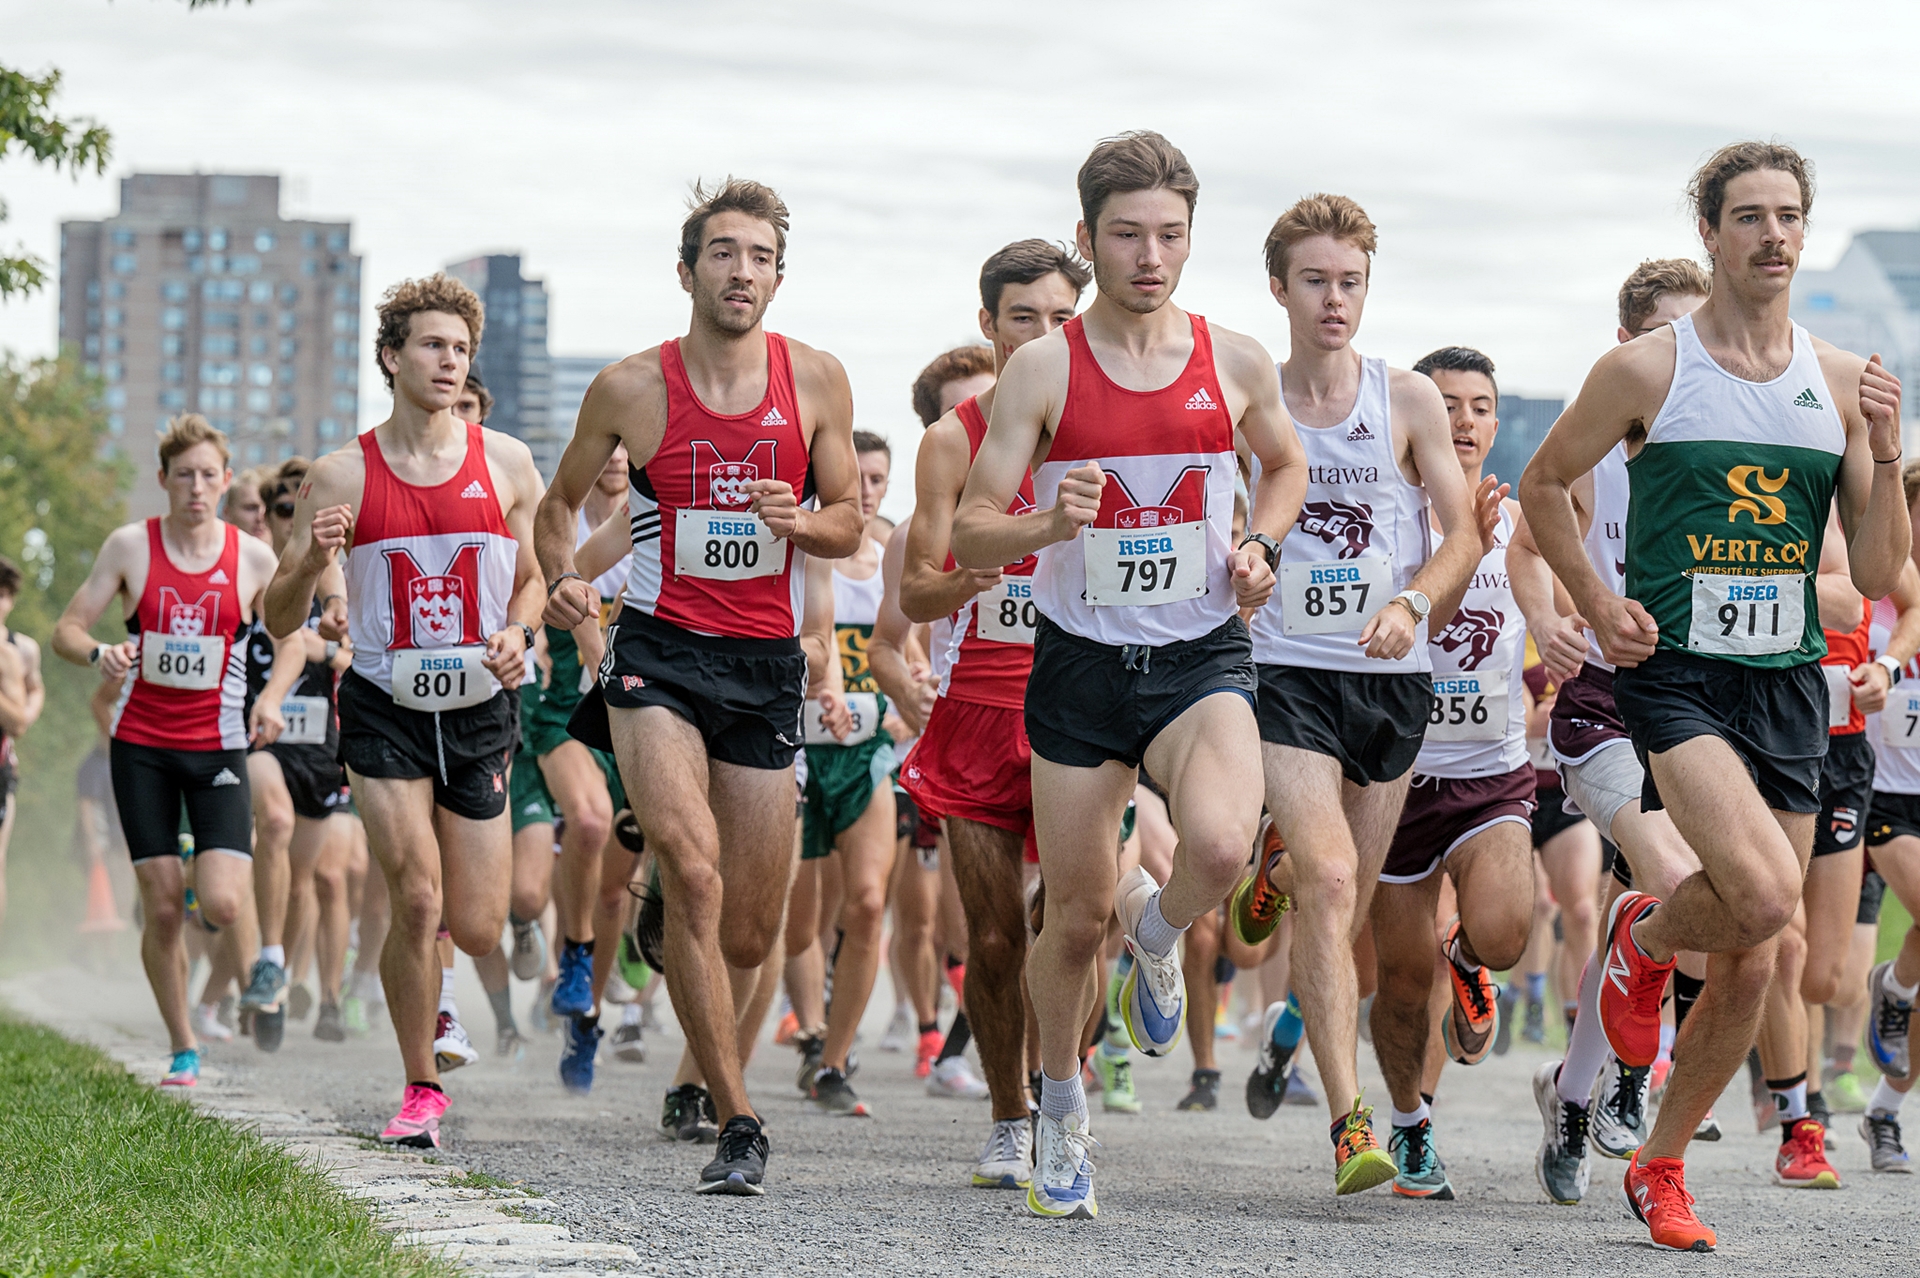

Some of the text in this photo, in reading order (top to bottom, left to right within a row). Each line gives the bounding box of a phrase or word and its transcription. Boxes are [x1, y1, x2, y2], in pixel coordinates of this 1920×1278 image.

[1185, 401, 1217, 410] adidas
[1793, 398, 1823, 411] adidas
[761, 418, 788, 427] adidas
[1347, 433, 1375, 442] adidas
[461, 490, 488, 499] adidas
[707, 521, 757, 536] RSEQ
[704, 539, 759, 568] 800
[1118, 537, 1174, 555] RSEQ
[1686, 534, 1762, 562] VERT
[1763, 547, 1779, 563] &
[1117, 556, 1177, 592] 797
[1310, 567, 1361, 584] RSEQ
[1746, 568, 1758, 576] DE
[1007, 584, 1031, 598] RS
[1728, 585, 1778, 600] RSEQ
[1305, 583, 1370, 617] 857
[999, 599, 1039, 628] 80
[1718, 603, 1779, 636] 911
[159, 653, 205, 676] 804
[420, 657, 464, 670] RSEQ
[413, 672, 466, 697] 801
[1433, 680, 1481, 693] RSEQ
[1428, 695, 1488, 725] 856
